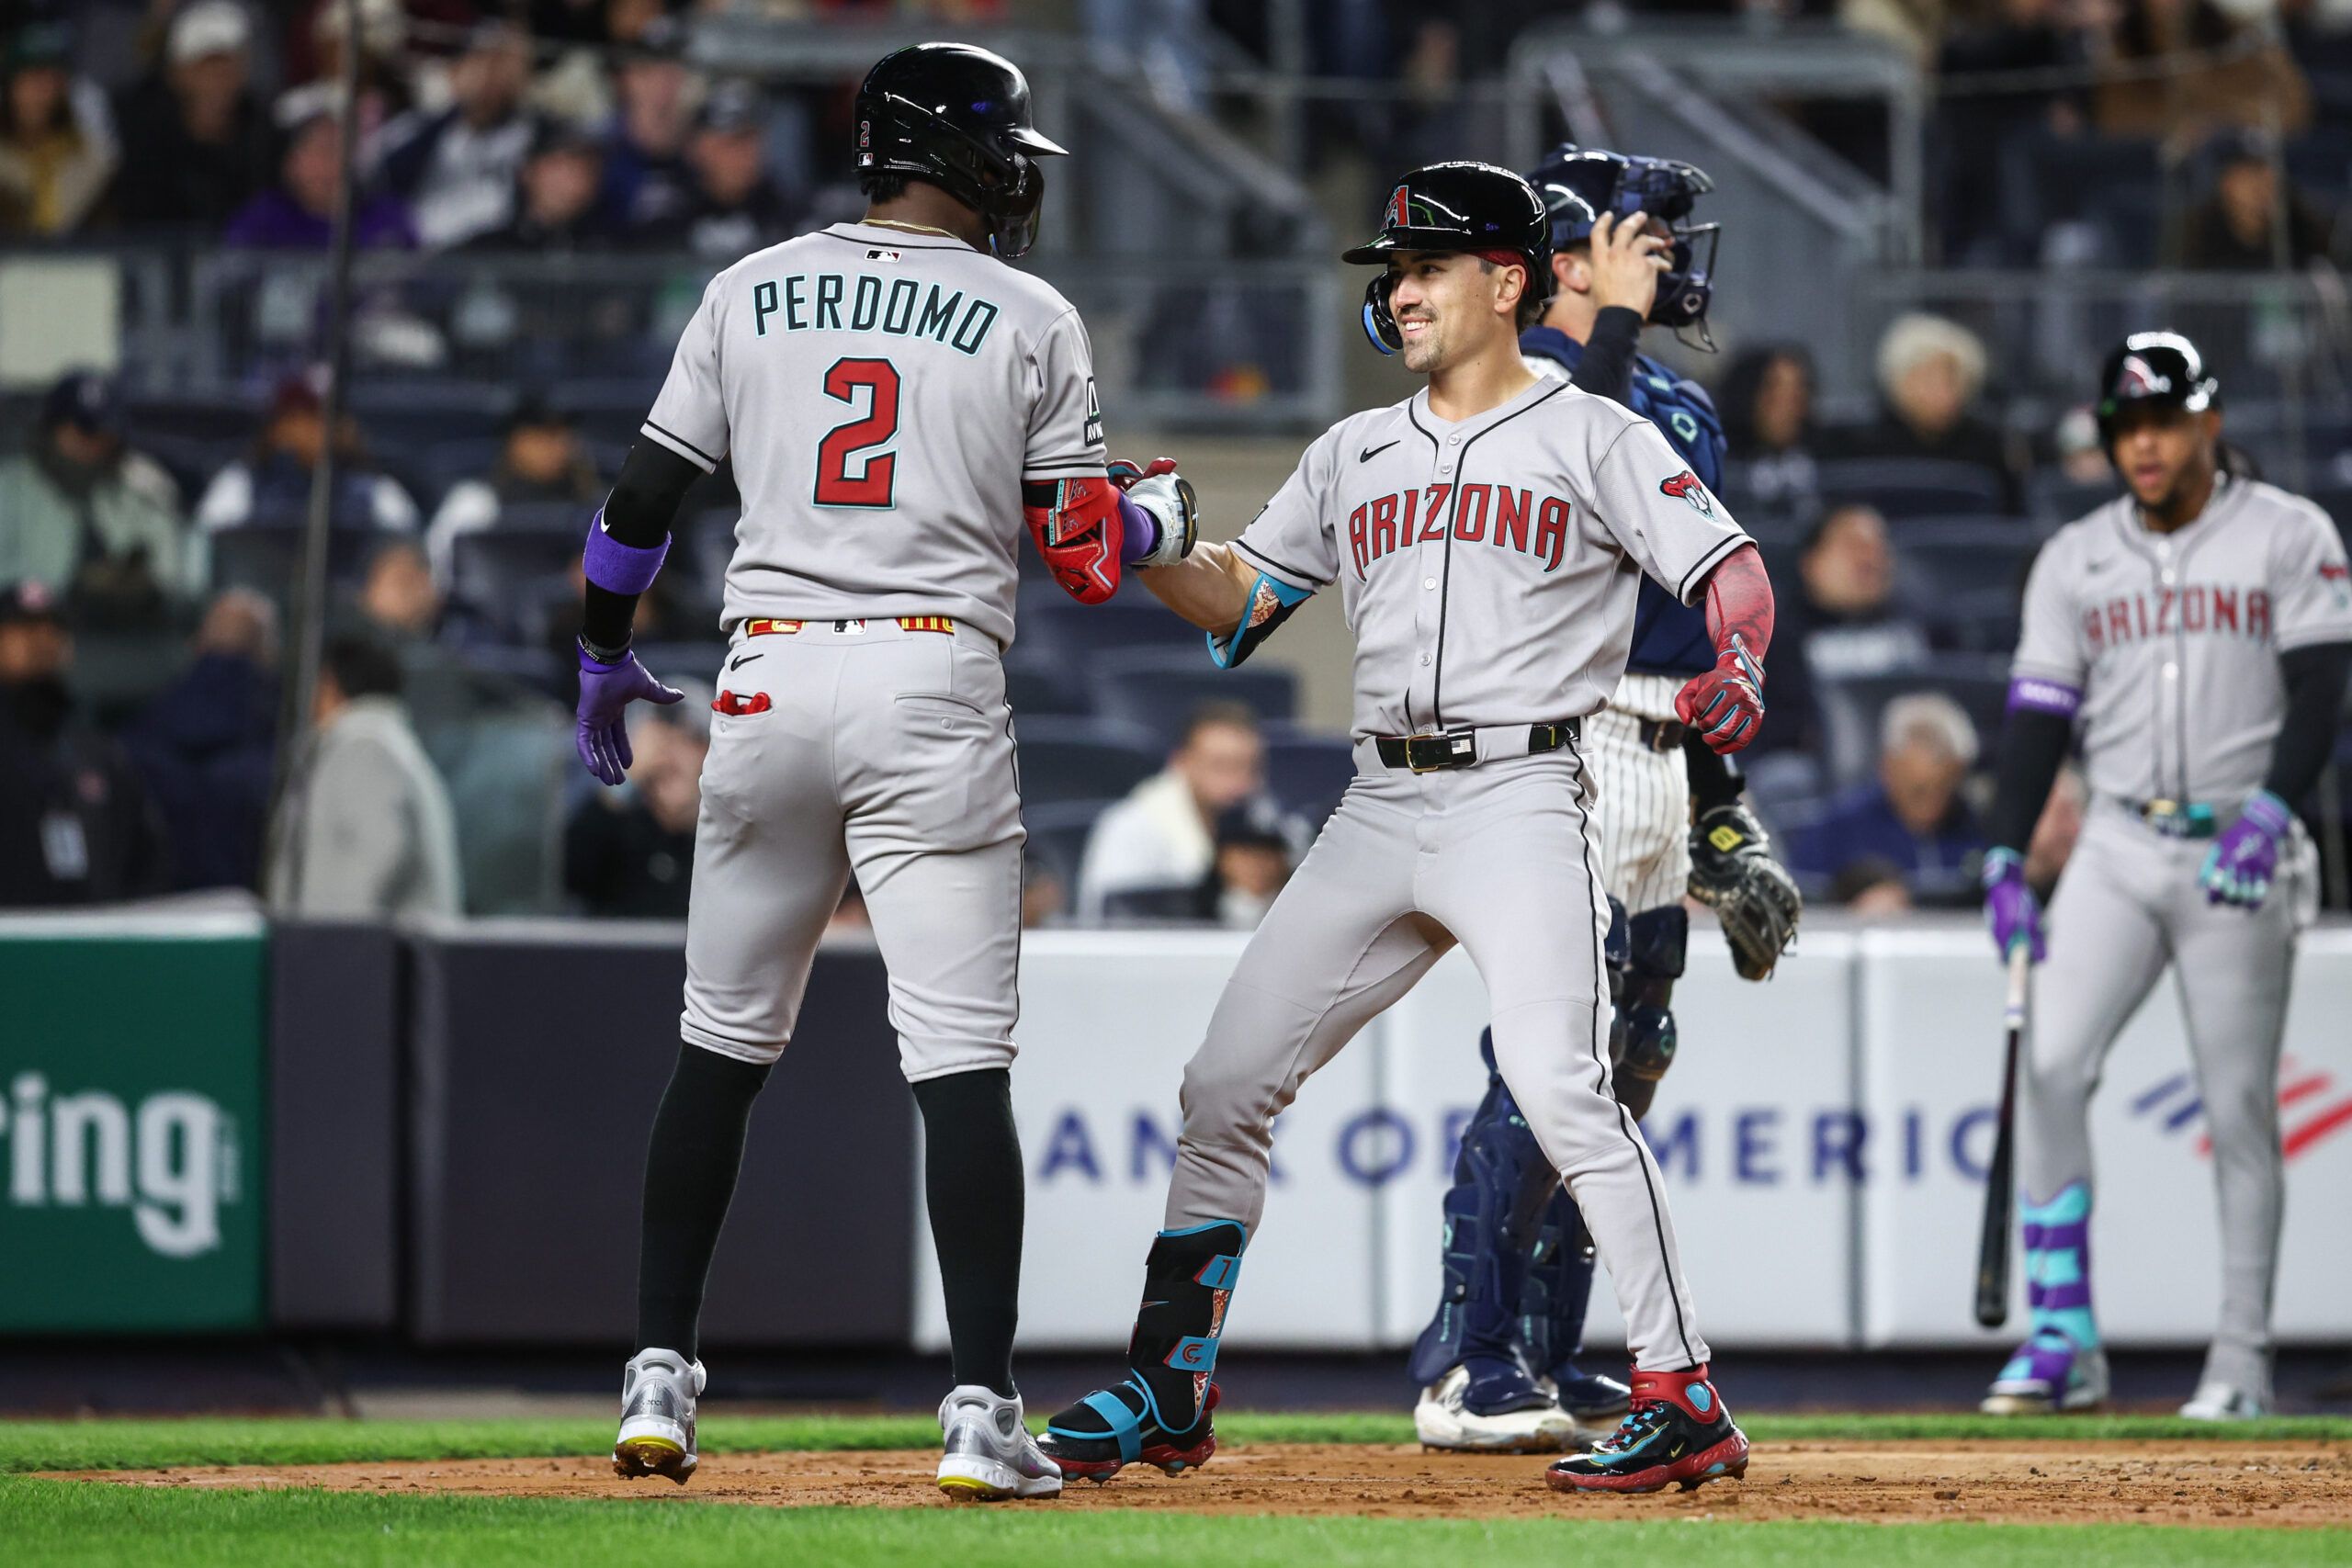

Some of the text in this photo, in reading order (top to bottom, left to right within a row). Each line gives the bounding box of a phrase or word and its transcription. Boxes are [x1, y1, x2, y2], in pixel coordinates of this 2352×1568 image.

[859, 120, 871, 148] 2
[753, 275, 1000, 357] PERDOMO
[812, 355, 904, 510] 2
[1348, 482, 1572, 581] ARIZONA
[2081, 585, 2273, 650] ARIZONA
[1643, 1108, 2001, 1183] MERIC
